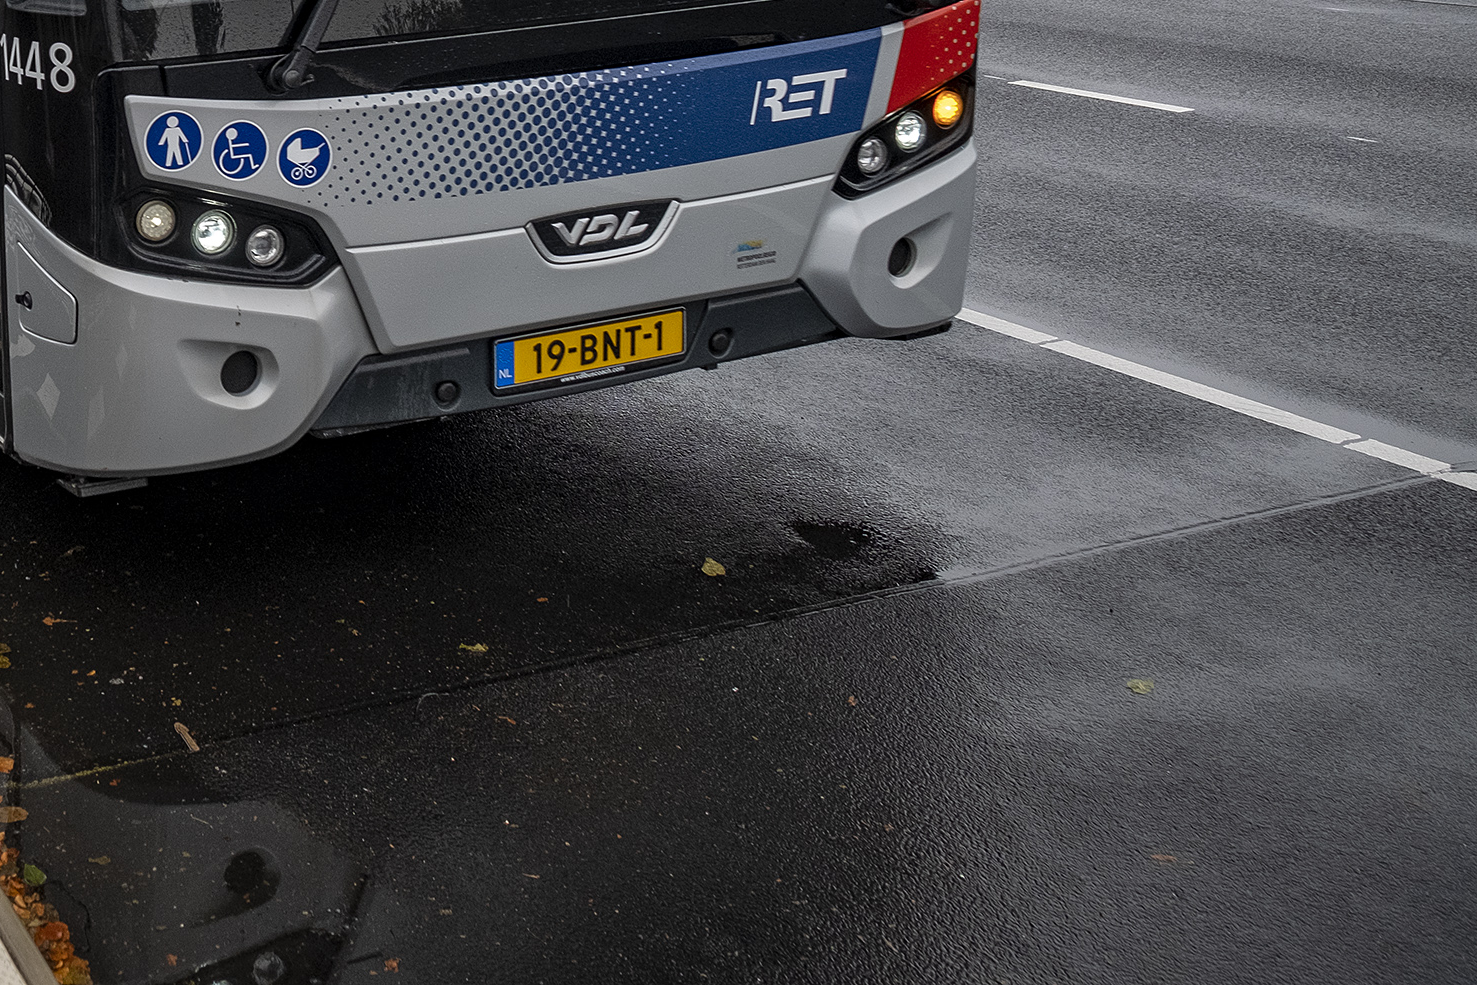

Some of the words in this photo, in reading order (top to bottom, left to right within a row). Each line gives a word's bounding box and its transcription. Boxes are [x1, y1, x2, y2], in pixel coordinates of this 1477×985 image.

[0, 33, 76, 93] 1448
[750, 68, 848, 125] RET
[551, 210, 649, 246] VDL
[498, 369, 512, 379] NL
[533, 320, 663, 374] 19-BNT-1
